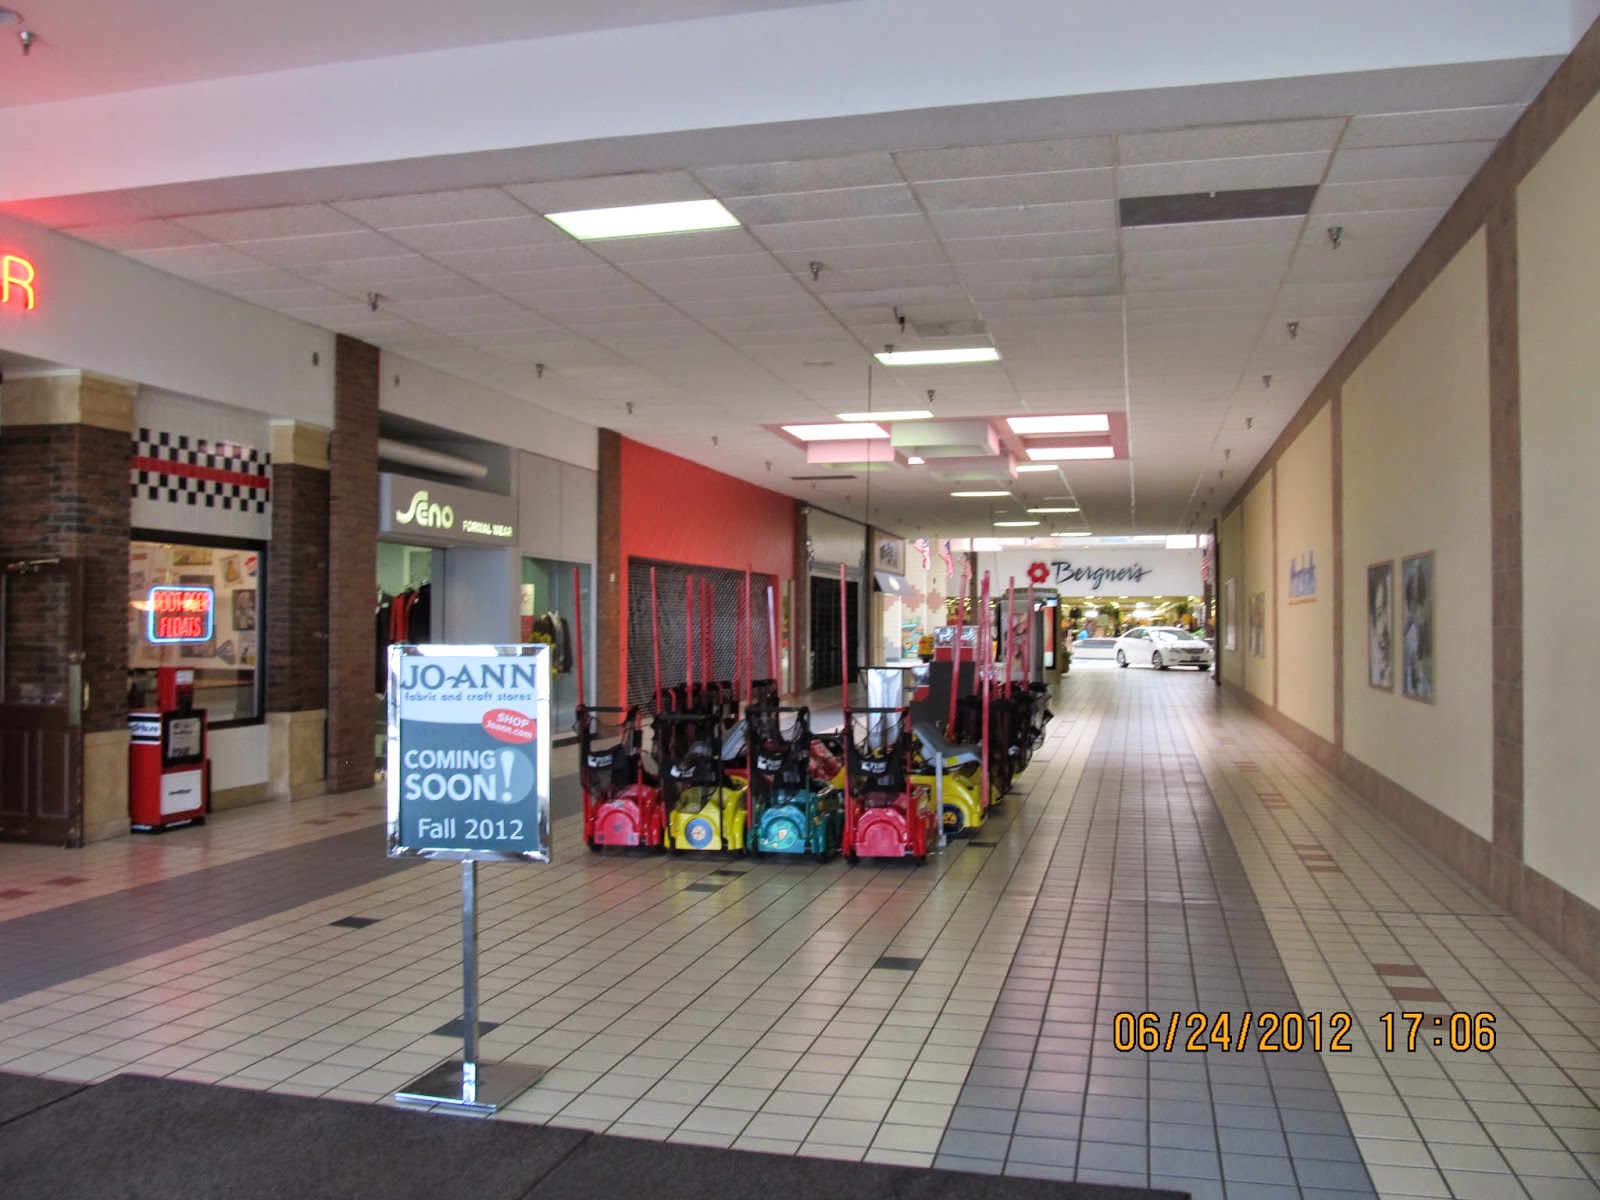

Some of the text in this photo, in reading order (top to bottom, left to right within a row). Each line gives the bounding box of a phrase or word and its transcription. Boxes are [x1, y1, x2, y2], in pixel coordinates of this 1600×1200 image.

[462, 519, 513, 538] FORMAL WEAR
[1052, 561, 1152, 590] Bergner's
[159, 616, 202, 637] FLOATS
[405, 691, 532, 702] fabric and craft stores
[496, 712, 530, 728] SHOP
[404, 749, 496, 770] COMING
[418, 818, 524, 840] Fall 2012
